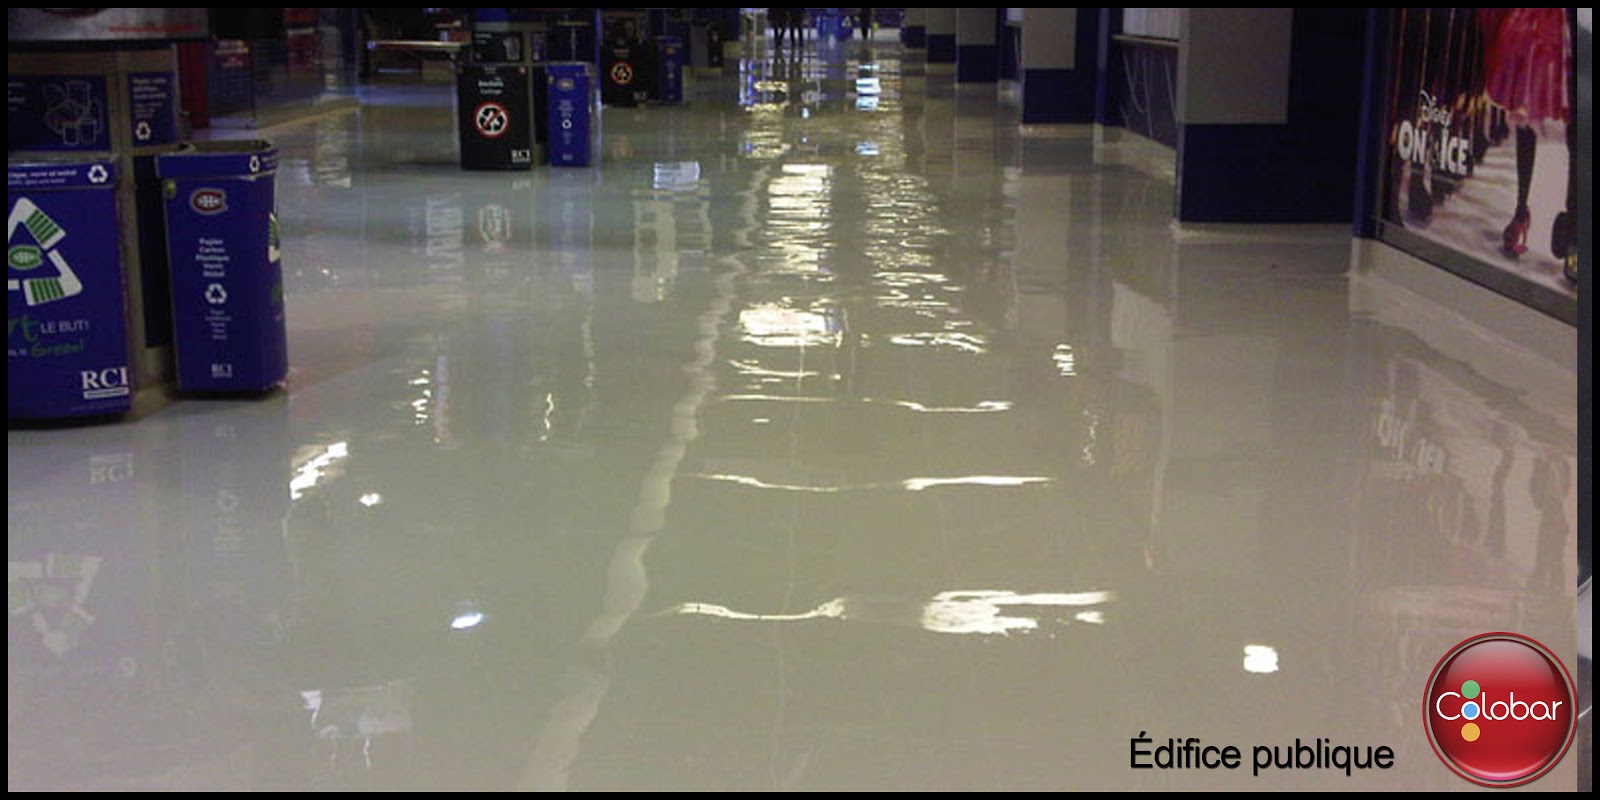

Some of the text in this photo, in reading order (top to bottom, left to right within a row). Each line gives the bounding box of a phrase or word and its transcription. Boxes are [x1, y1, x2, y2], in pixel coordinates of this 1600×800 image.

[1398, 119, 1469, 176] ON ICE
[40, 321, 57, 334] LE
[81, 366, 129, 389] RCI
